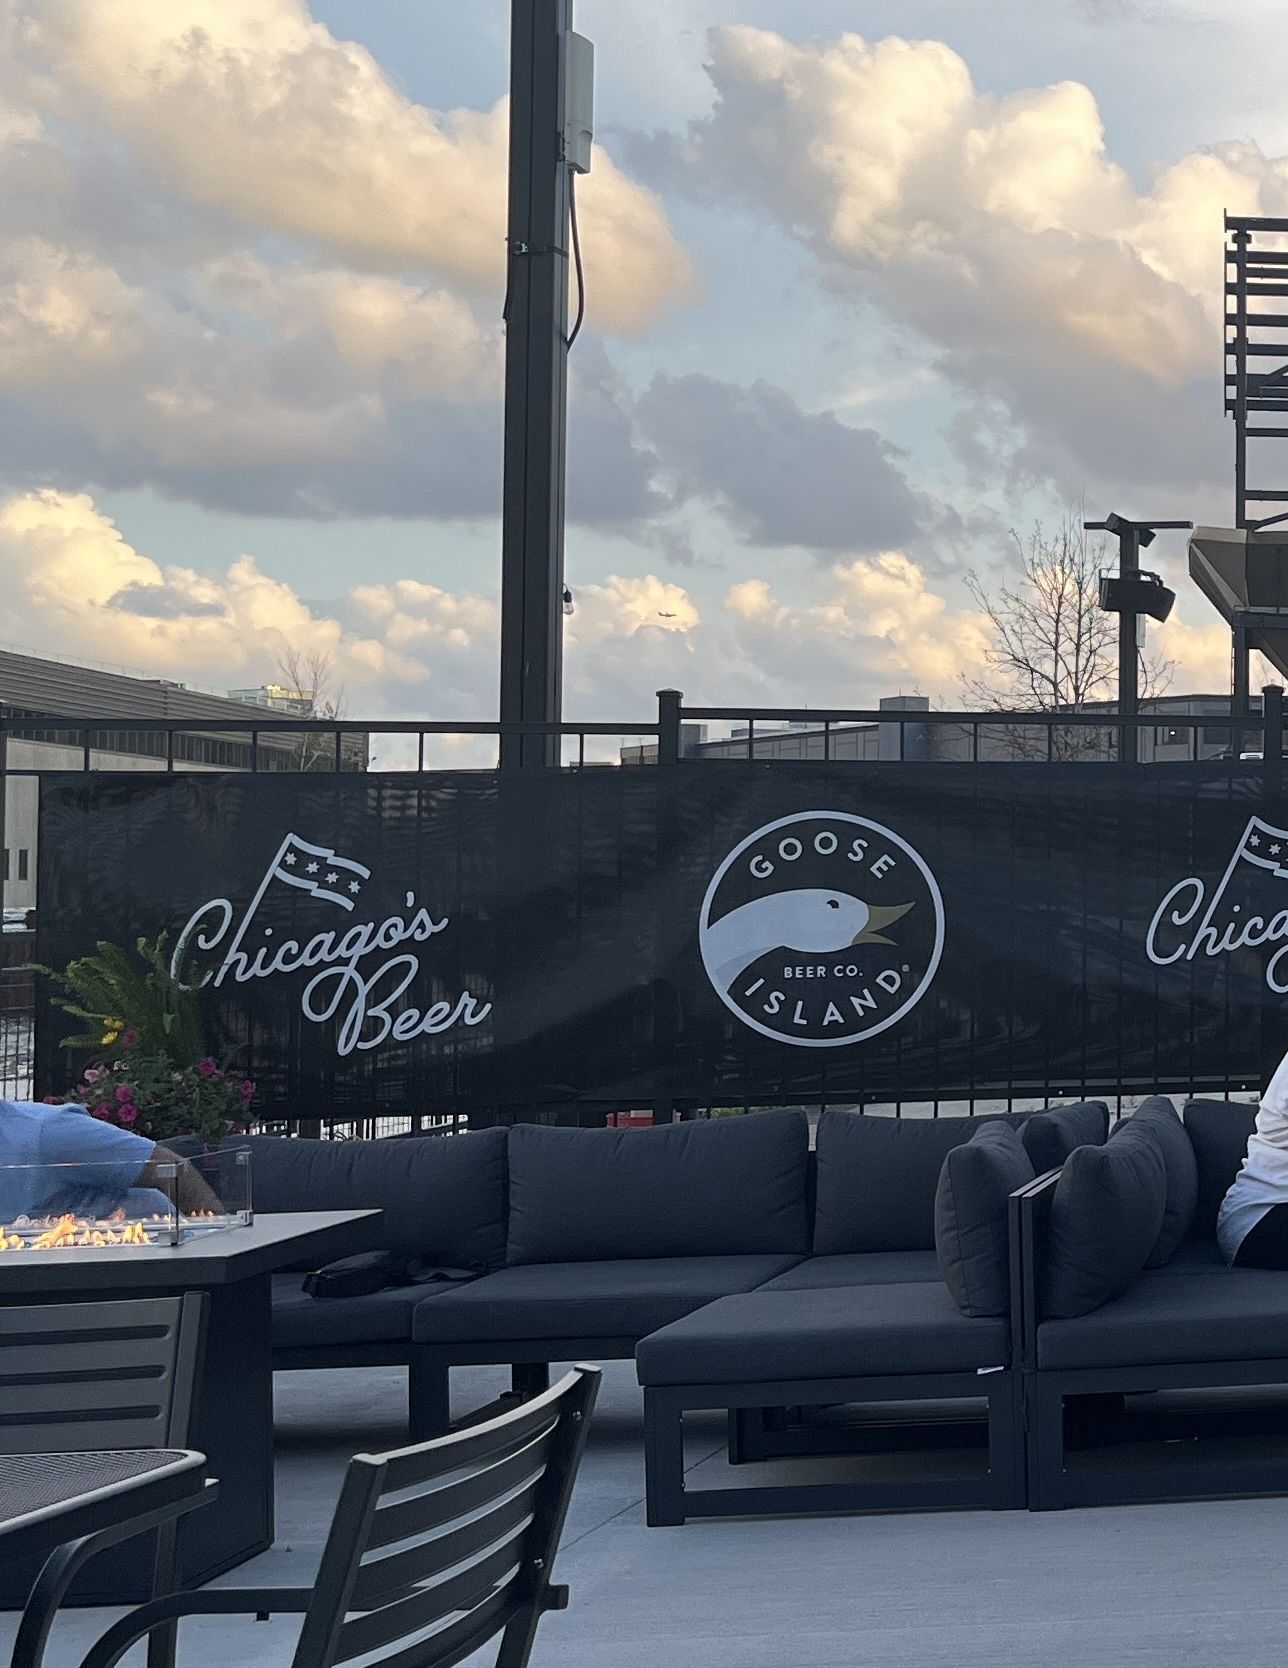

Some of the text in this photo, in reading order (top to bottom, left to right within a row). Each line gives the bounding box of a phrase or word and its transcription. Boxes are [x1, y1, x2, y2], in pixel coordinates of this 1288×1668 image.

[749, 831, 897, 879] GOOSE
[169, 868, 449, 991] Chicago's
[302, 955, 492, 1056] Beer
[783, 965, 864, 979] BEER CO.
